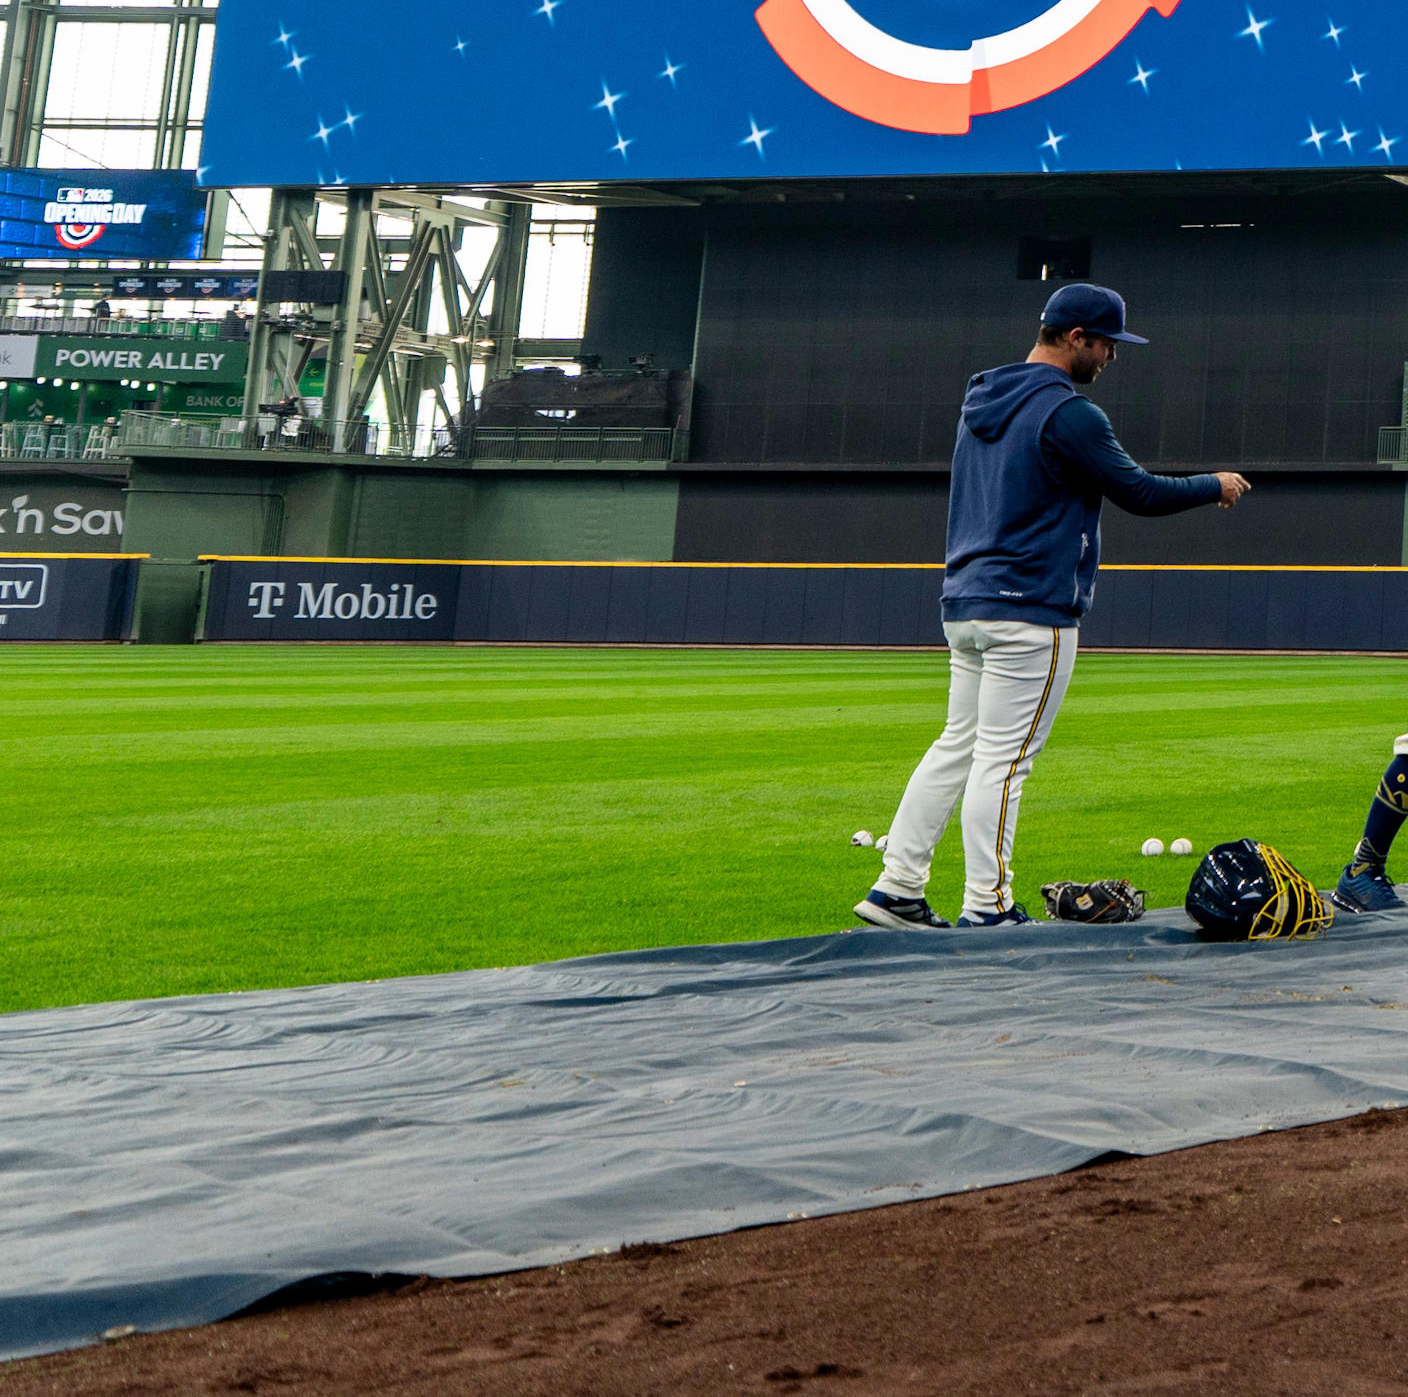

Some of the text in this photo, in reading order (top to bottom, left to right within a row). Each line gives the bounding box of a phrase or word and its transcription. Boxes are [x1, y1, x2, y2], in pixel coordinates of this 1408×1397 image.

[43, 202, 148, 224] OPENING DAY
[55, 348, 225, 371] POWER ALLEY
[186, 395, 225, 408] BANK
[294, 582, 438, 621] Mobile
